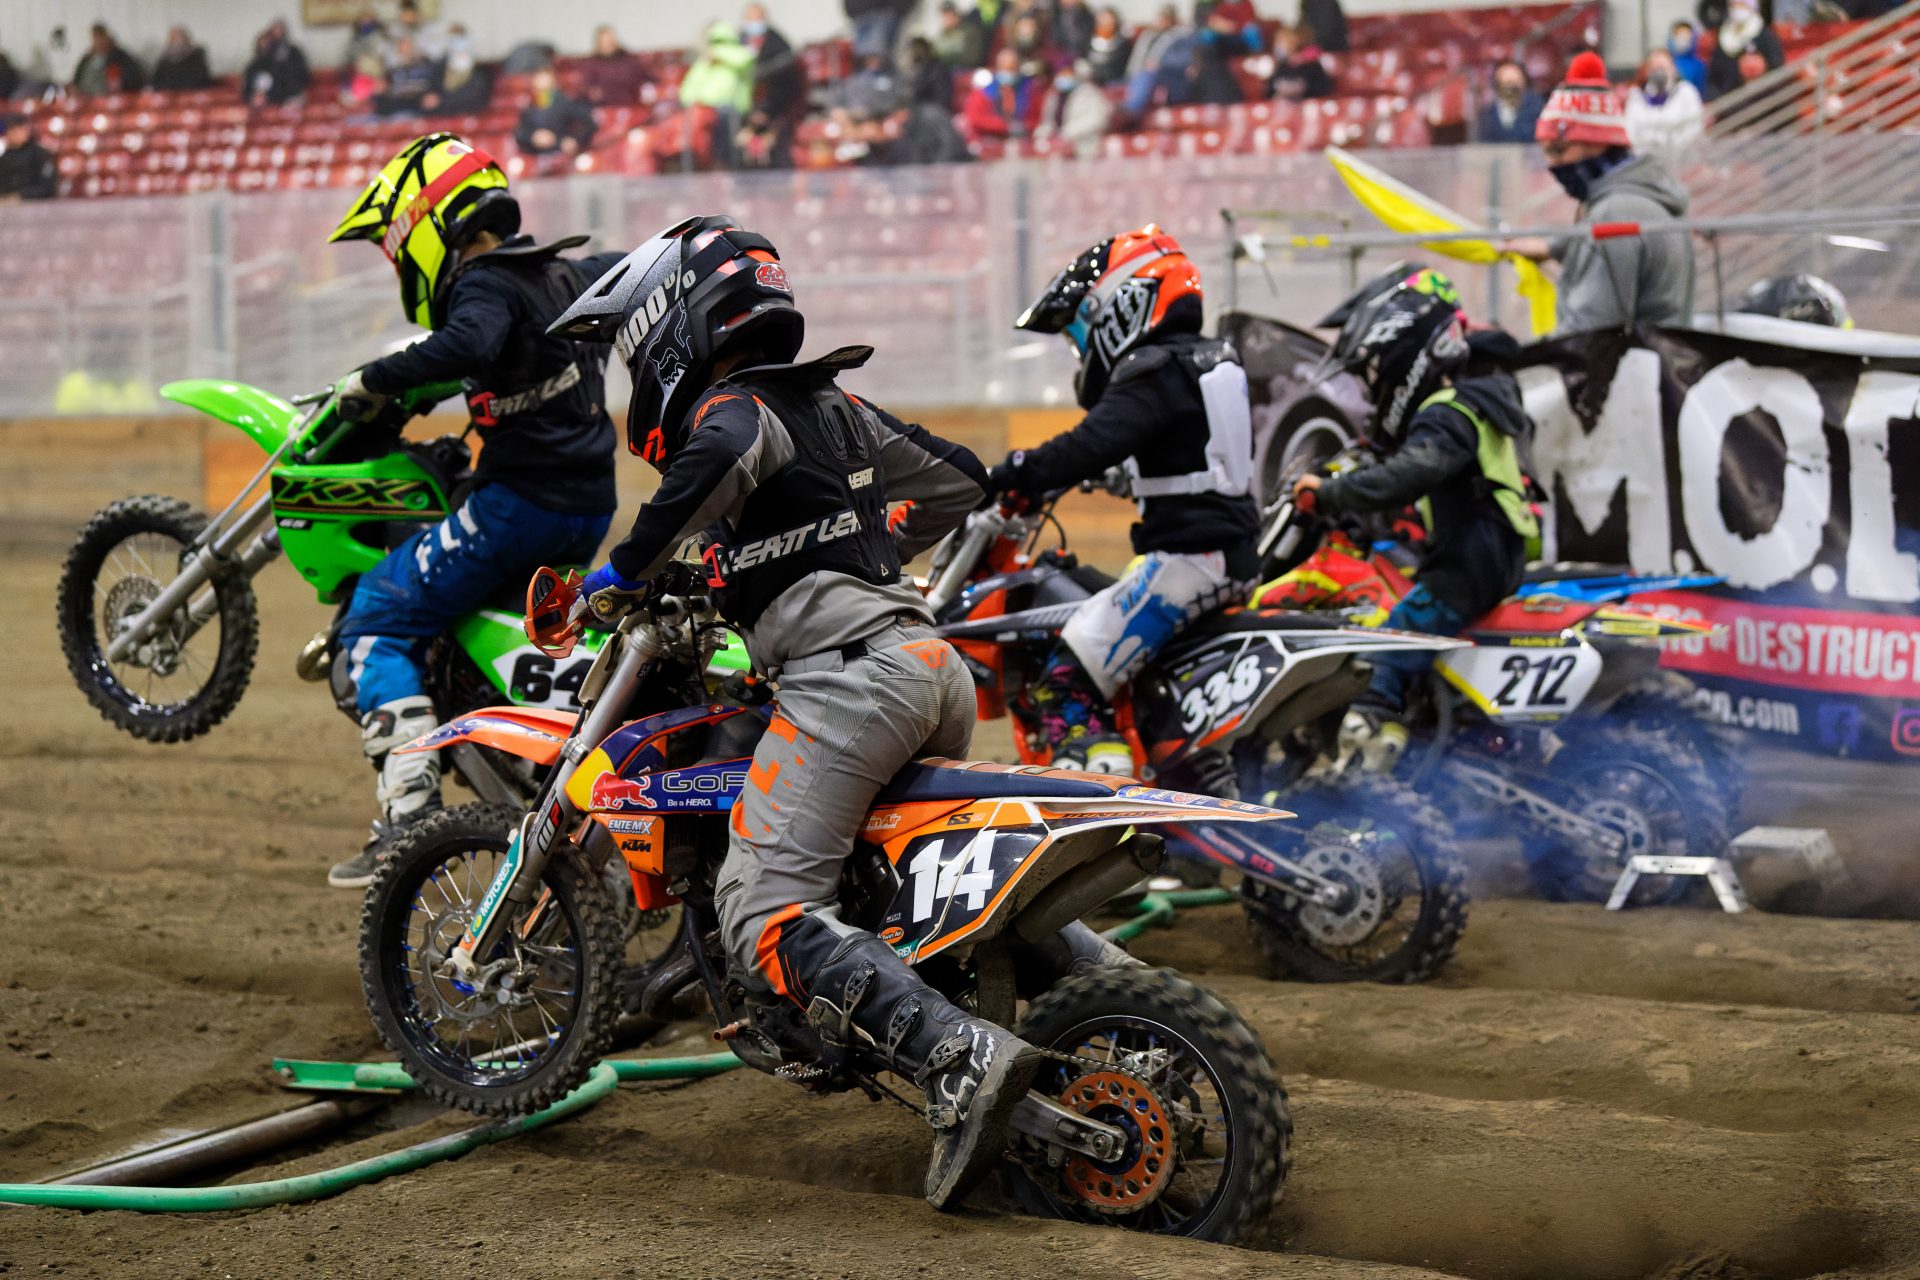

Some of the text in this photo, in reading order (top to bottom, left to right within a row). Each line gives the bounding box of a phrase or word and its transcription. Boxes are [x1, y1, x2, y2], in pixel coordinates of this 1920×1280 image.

[614, 264, 697, 359] 100%
[848, 467, 874, 490] LEATT
[1181, 654, 1262, 734] 338
[1493, 654, 1577, 706] 212
[621, 838, 652, 852] KTM
[480, 861, 514, 917] MOTOREX
[909, 829, 998, 923] 14
